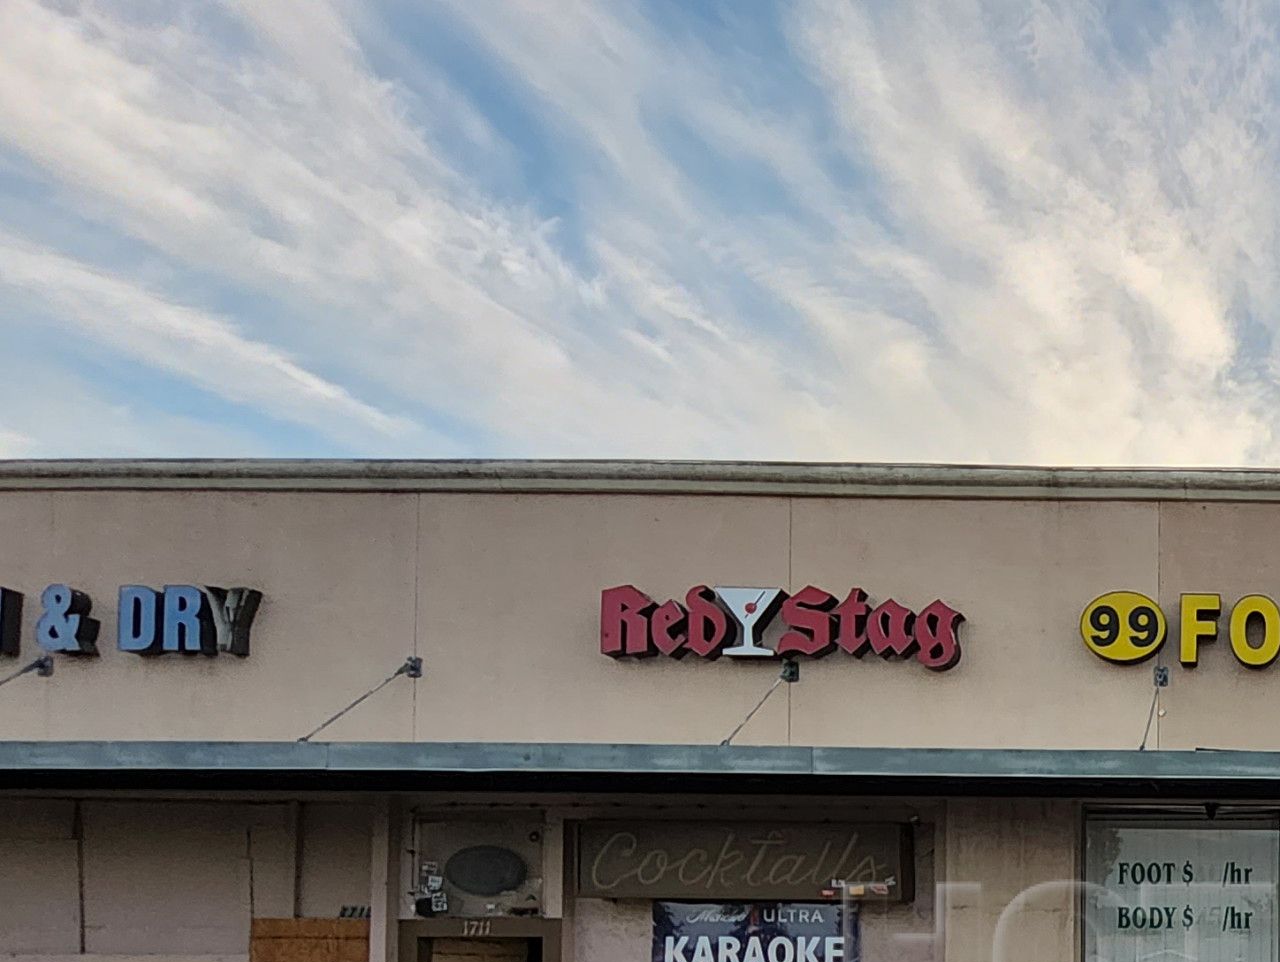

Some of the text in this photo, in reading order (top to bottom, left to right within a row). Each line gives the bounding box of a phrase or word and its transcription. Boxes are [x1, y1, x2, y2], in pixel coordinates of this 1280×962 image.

[37, 584, 90, 652] &
[117, 584, 258, 656] DRY
[1089, 603, 1160, 648] 99
[1118, 862, 1176, 885] FOOT
[763, 908, 823, 923] ULTRA
[1118, 906, 1177, 929] BODY
